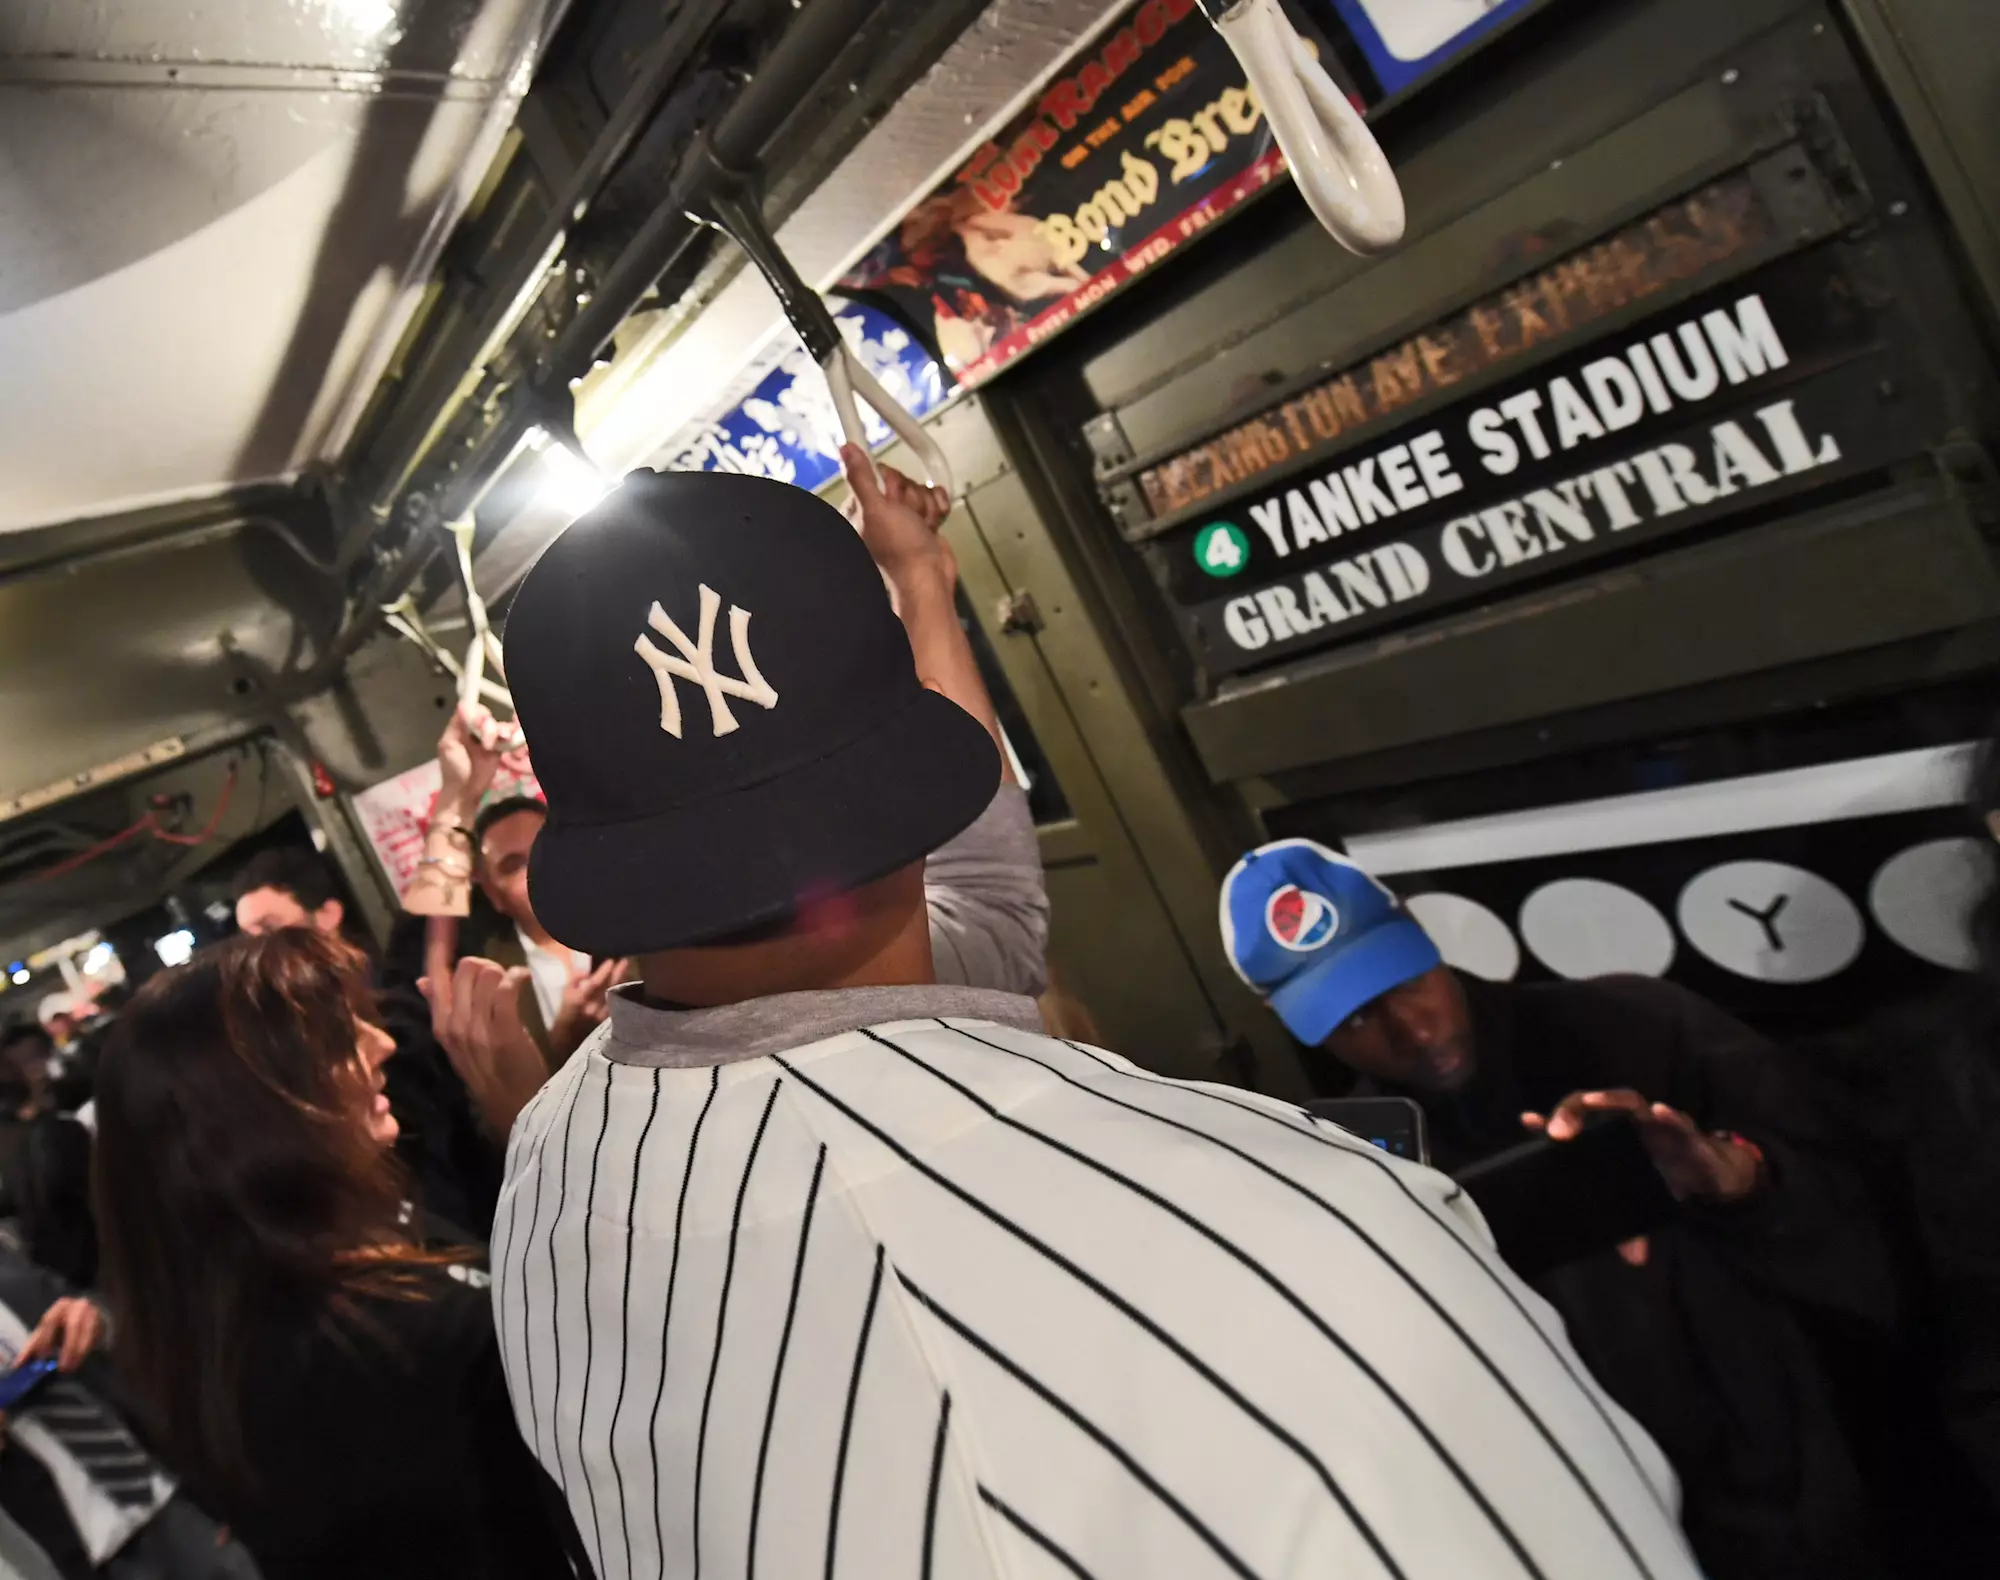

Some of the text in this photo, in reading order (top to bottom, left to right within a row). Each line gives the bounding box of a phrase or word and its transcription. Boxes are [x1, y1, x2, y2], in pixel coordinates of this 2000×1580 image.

[1032, 148, 1160, 270] Bond
[1204, 293, 1791, 568] 4 YANKEE STADIUM
[1371, 333, 1463, 415] AVE
[1223, 399, 1842, 650] GRAND CENTRAL
[633, 582, 780, 740] NY
